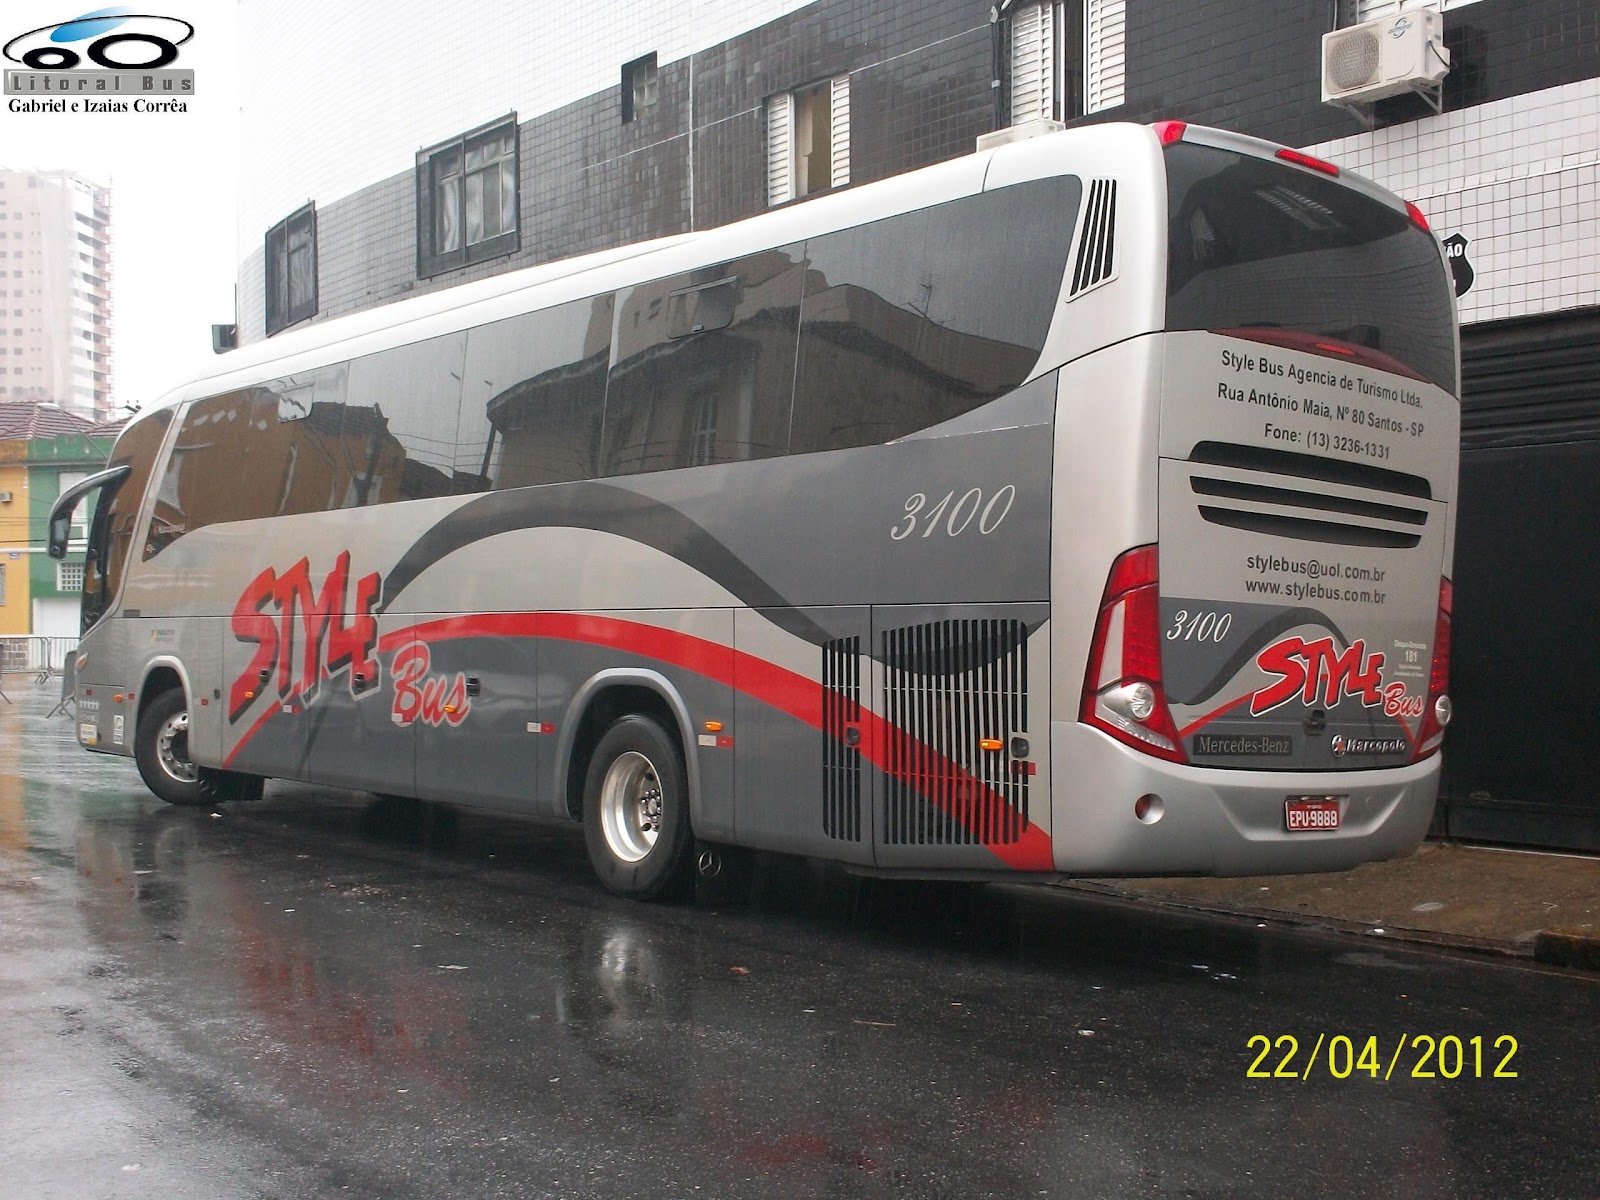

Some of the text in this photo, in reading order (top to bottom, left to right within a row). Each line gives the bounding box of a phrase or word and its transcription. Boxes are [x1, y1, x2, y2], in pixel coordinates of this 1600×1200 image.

[1221, 349, 1424, 409] Style Bus Agencia de Turismo Ltda.
[1217, 382, 1245, 402] Rua
[1248, 388, 1299, 412] Antônio
[1303, 398, 1333, 421] Maia,
[1352, 408, 1365, 426] 80
[1367, 412, 1403, 433] Santos
[1264, 423, 1391, 460] Fone: (13) 3236-1331
[890, 484, 1016, 541] 3100
[1246, 554, 1386, 583] stylebus@uol.com.br
[1245, 579, 1387, 605] www.stylebus.com.br
[229, 549, 471, 727] STYLE Bus
[1166, 609, 1232, 643] 3100
[1405, 650, 1418, 663] 181
[1249, 635, 1425, 718] STYLE Bus
[1199, 736, 1290, 754] Mercedes-Benz
